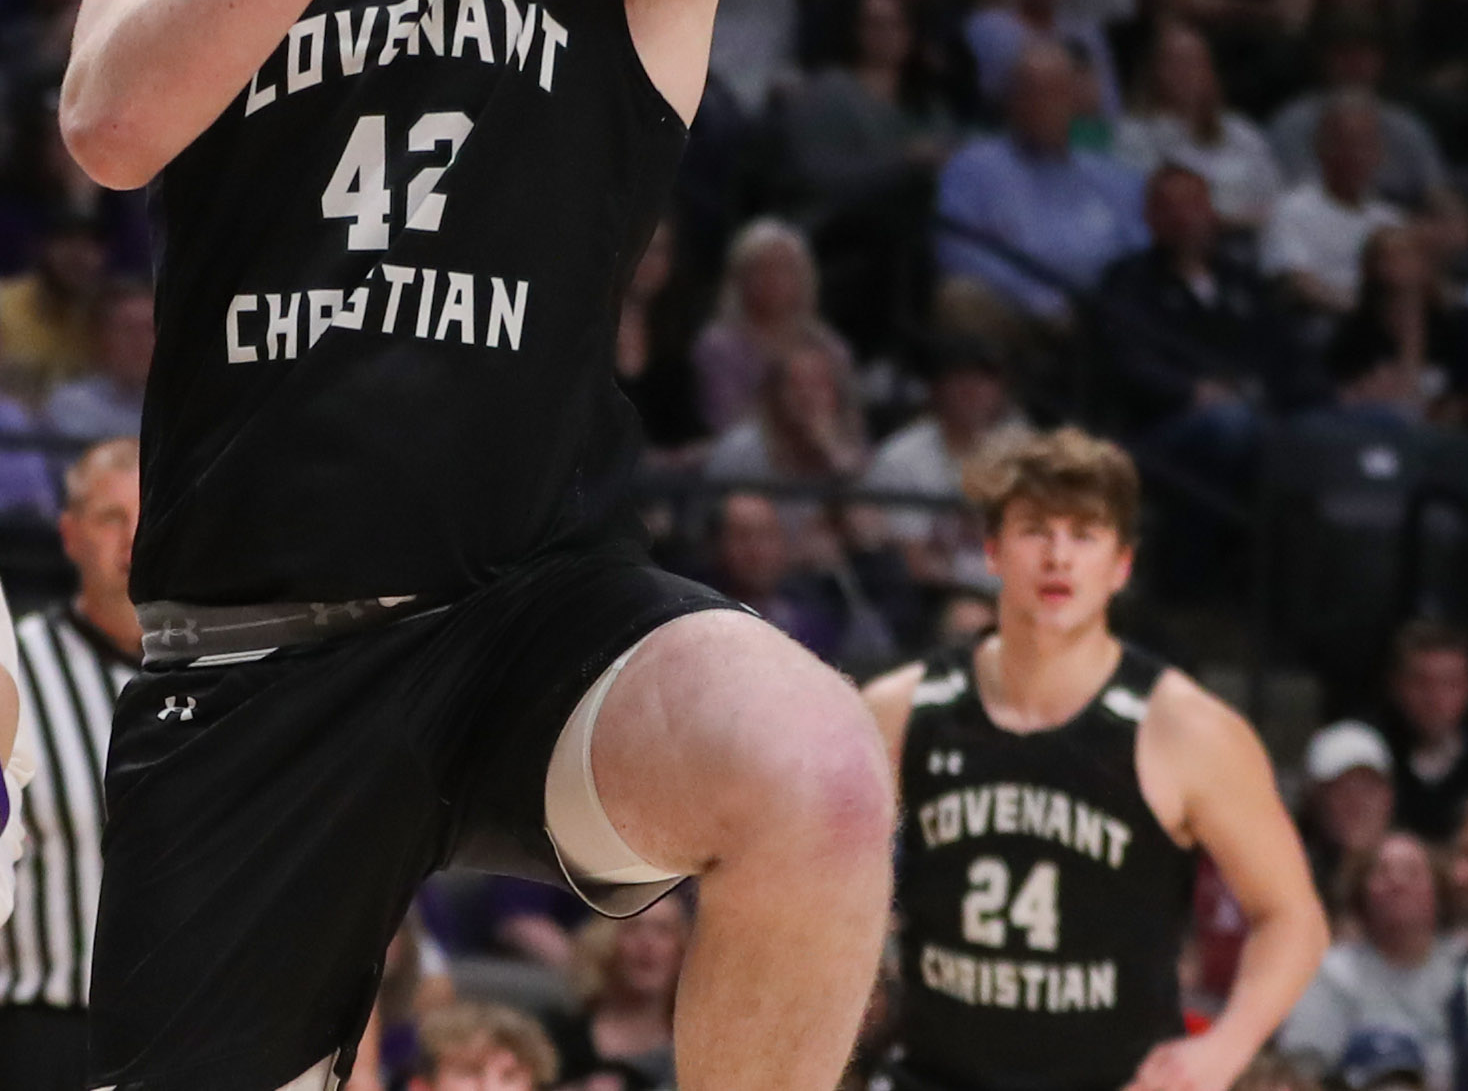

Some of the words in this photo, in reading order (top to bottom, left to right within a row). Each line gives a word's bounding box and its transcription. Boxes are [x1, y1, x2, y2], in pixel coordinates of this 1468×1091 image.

[321, 111, 475, 251] 42
[919, 782, 1132, 870] COVENANT
[961, 856, 1060, 952] 24
